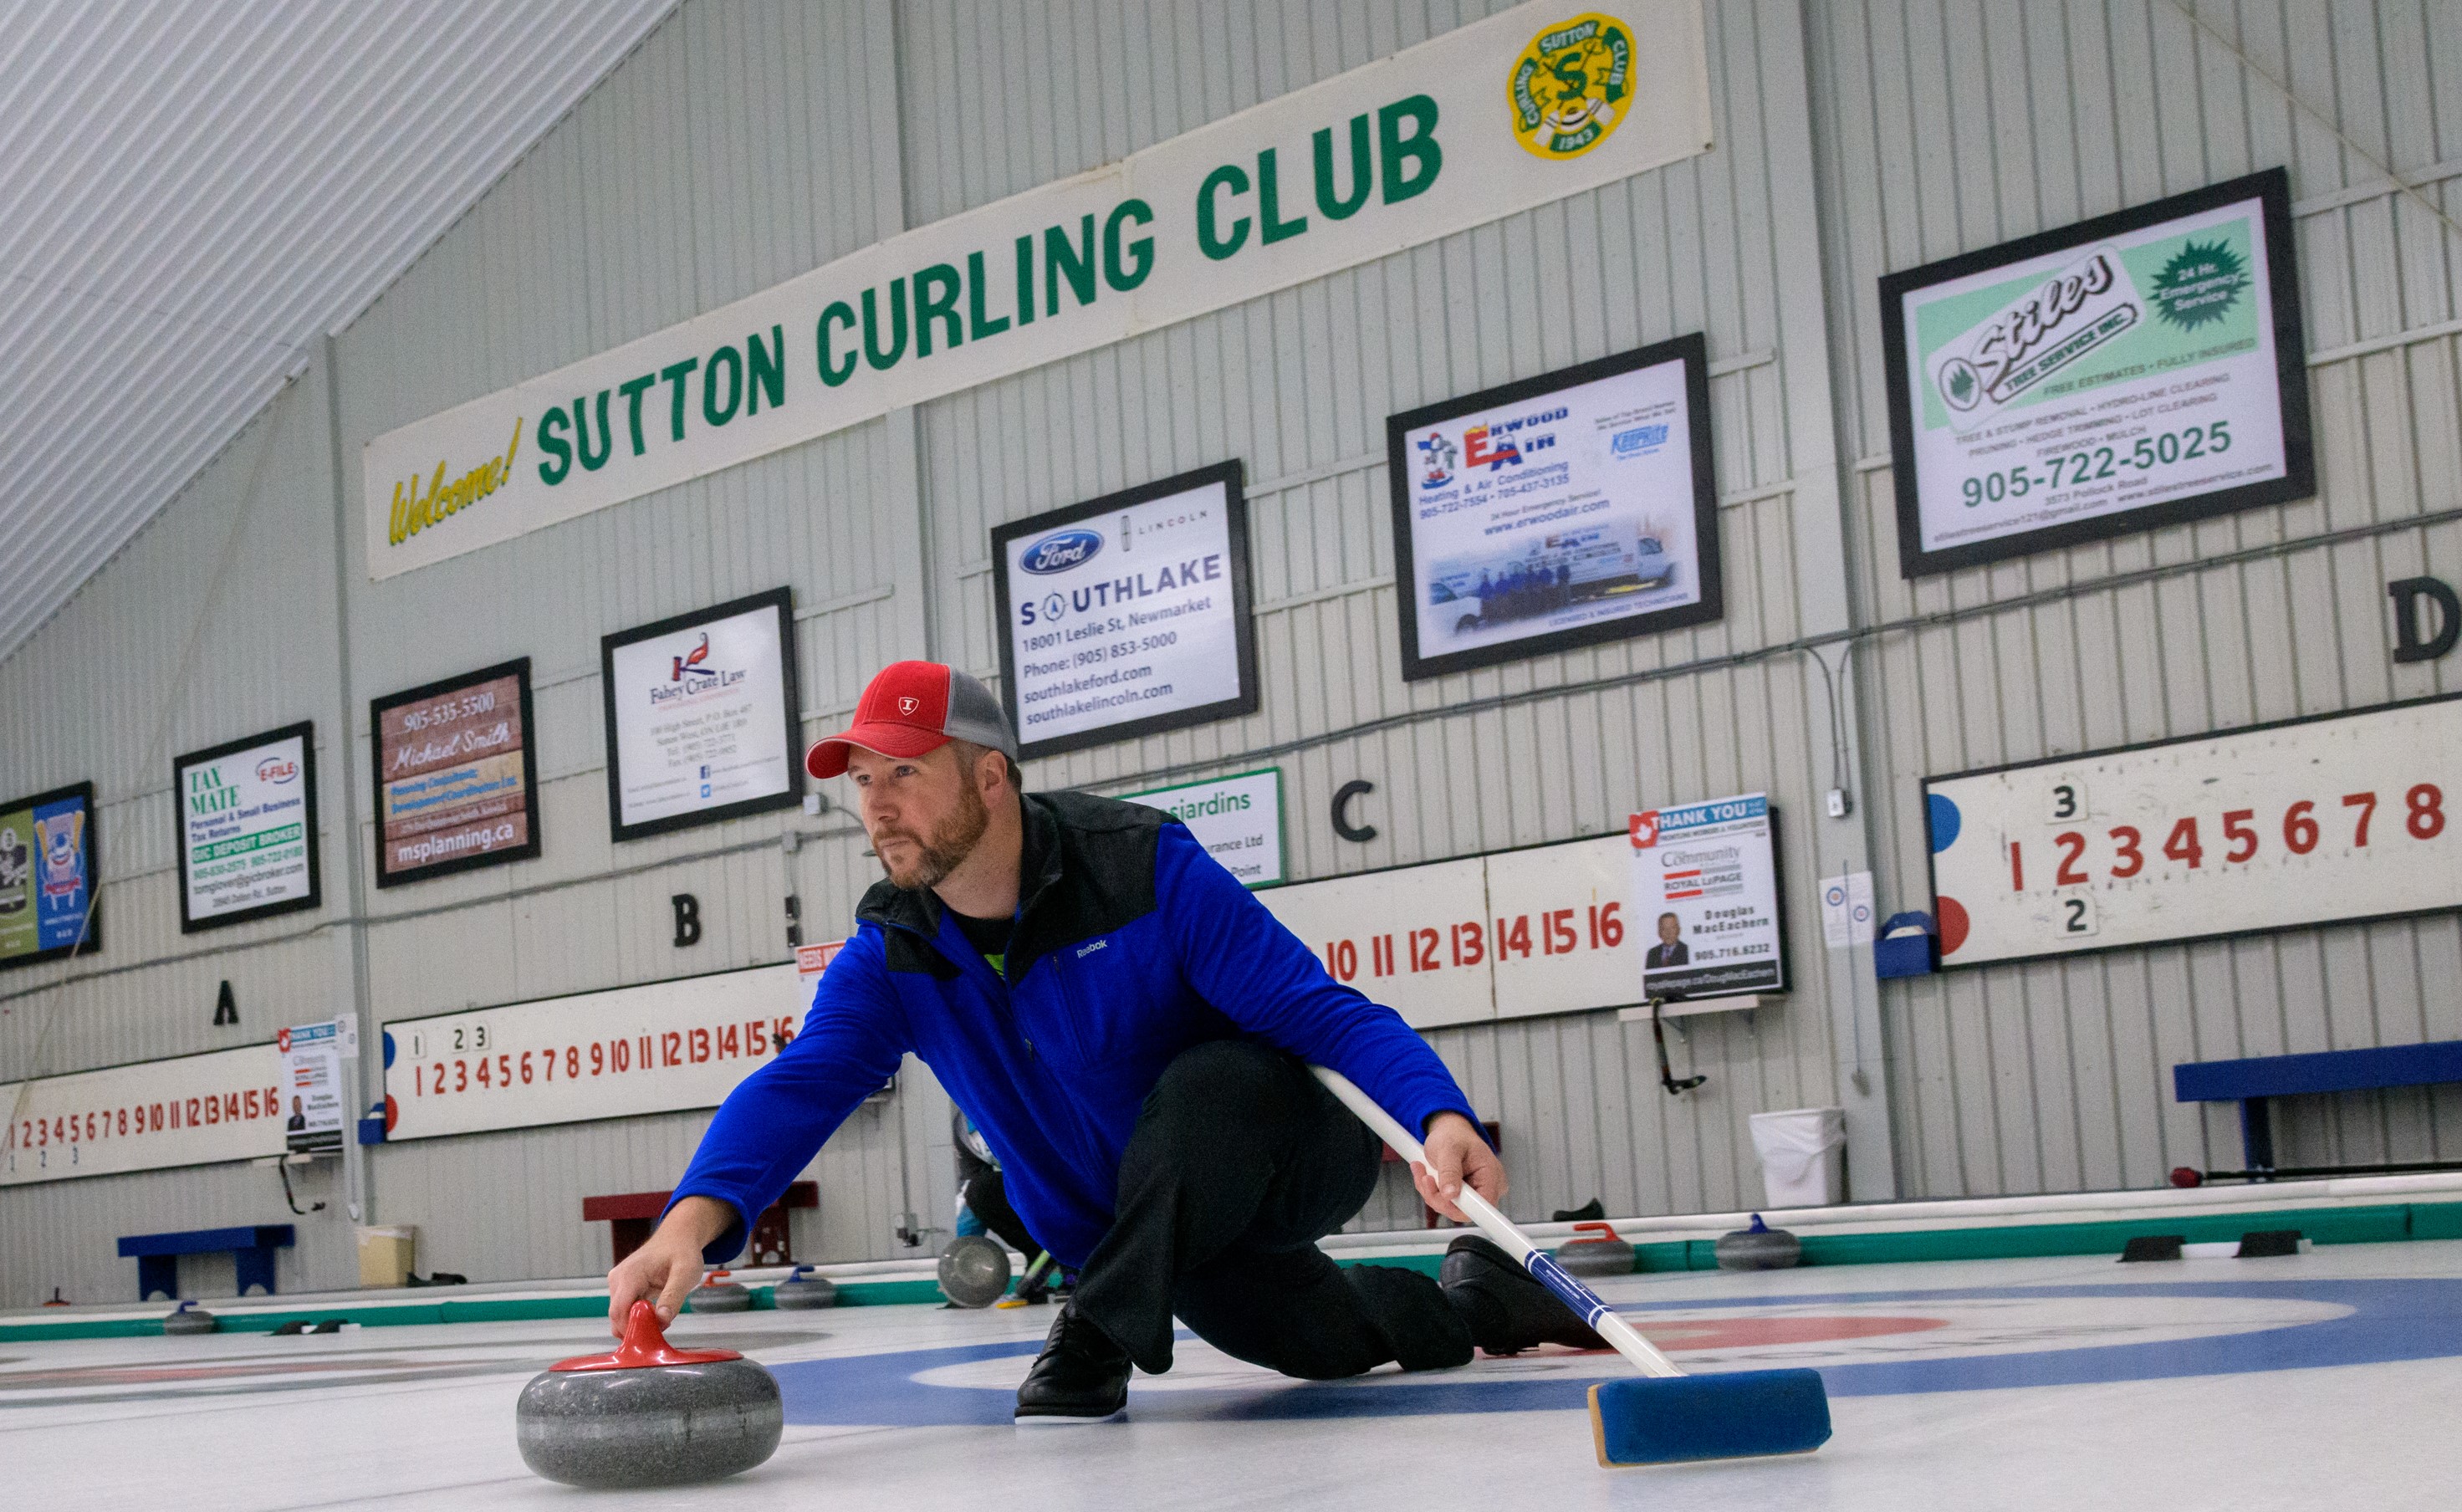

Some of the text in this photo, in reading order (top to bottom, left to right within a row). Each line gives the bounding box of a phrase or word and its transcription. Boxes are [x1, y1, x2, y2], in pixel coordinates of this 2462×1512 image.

[1540, 22, 1596, 54] SUTTON
[1554, 52, 1587, 101] S
[1609, 39, 1626, 85] CLUB
[2162, 273, 2239, 301] Emergency
[2179, 263, 2218, 283] 24 Hr.
[2175, 290, 2226, 311] Service
[389, 94, 1443, 546] Welcome! SUTTON CURLING CLUB
[1970, 253, 2113, 391] Stiles
[2006, 313, 2127, 392] TREE SERVICE INC.
[2043, 338, 2255, 395] FREE ESTIMATES FULLY INSURED
[2169, 374, 2230, 396] CLEARING
[2131, 406, 2154, 420] LOT
[2157, 393, 2217, 415] CLEARING
[2107, 426, 2147, 441] MULCH
[1962, 421, 2232, 508] 905-722-5025
[1419, 462, 1569, 505] Heating & Air Conditioning
[1420, 473, 1570, 519] 905-722-7554 705-437-3135
[2117, 477, 2148, 490] Road
[1139, 510, 1207, 535] LINCOLN
[1484, 499, 1610, 535] www.erwoodair.com
[1523, 499, 1566, 515] Emergency
[1035, 537, 1086, 570] Ford
[1023, 596, 1211, 652] 18001 Leslie Newmarket
[2388, 575, 2461, 664] D
[1024, 631, 1177, 678] Phone: (905) 853-5000
[686, 672, 718, 695] Crate
[722, 669, 747, 687] Law
[1024, 664, 1152, 703] southlakeford.com
[1026, 682, 1172, 725] southlakelincoln.com
[392, 721, 510, 771] Michael Smith
[191, 765, 222, 793] TAX
[260, 762, 294, 781] E-FILE
[191, 785, 240, 817] MATE
[191, 797, 299, 829] Personal & Small Business
[1331, 779, 1377, 844] C
[1651, 809, 1708, 830] THANK
[1711, 803, 1747, 820] YOU
[2053, 785, 2076, 818] 3
[192, 826, 241, 842] Tax Returns
[213, 836, 257, 856] DEPOSIT
[258, 825, 301, 845] BROKER
[398, 823, 513, 863] msplanning.ca
[1245, 835, 1263, 848] Ltd
[2010, 784, 2444, 891] 1 2 3 4 5 6 7 8
[1231, 865, 1261, 876] Point
[1662, 846, 1741, 867] Community
[1664, 878, 1700, 891] ROYAL
[672, 893, 702, 948] B
[1692, 918, 1770, 935] MacEachern
[1704, 905, 1755, 920] Douglas
[2065, 899, 2087, 932] 2
[1076, 939, 1108, 959] Reebok
[1326, 902, 1624, 983] 10 11 12 13 14 15 16
[213, 979, 240, 1027] A
[454, 1029, 463, 1050] 2
[476, 1026, 485, 1047] 3
[416, 1066, 421, 1096] 1
[433, 1063, 446, 1095] 2
[455, 1060, 467, 1092] 3
[476, 1057, 491, 1088] 4
[499, 1055, 511, 1087] 5
[520, 1050, 533, 1085] 6
[543, 1049, 556, 1080] 7
[566, 1046, 580, 1079] 8
[590, 1042, 604, 1076] 9
[610, 1039, 630, 1073] 10
[639, 1036, 653, 1069] 11
[661, 1032, 682, 1066] 12
[688, 1028, 710, 1064] 13
[717, 1024, 739, 1060] 14
[745, 1021, 767, 1057] 15
[23, 1121, 32, 1148] 2
[38, 1119, 48, 1146] 3
[54, 1116, 64, 1143] 4
[69, 1115, 79, 1142] 5
[86, 1112, 95, 1140] 6
[102, 1111, 112, 1137] 7
[118, 1109, 127, 1136] 8
[135, 1106, 145, 1134] 9
[150, 1103, 164, 1131] 10
[170, 1101, 181, 1128] 11
[186, 1098, 200, 1126] 12
[205, 1095, 219, 1125] 13
[224, 1092, 240, 1121] 14
[243, 1090, 259, 1119] 15
[264, 1086, 279, 1116] 16
